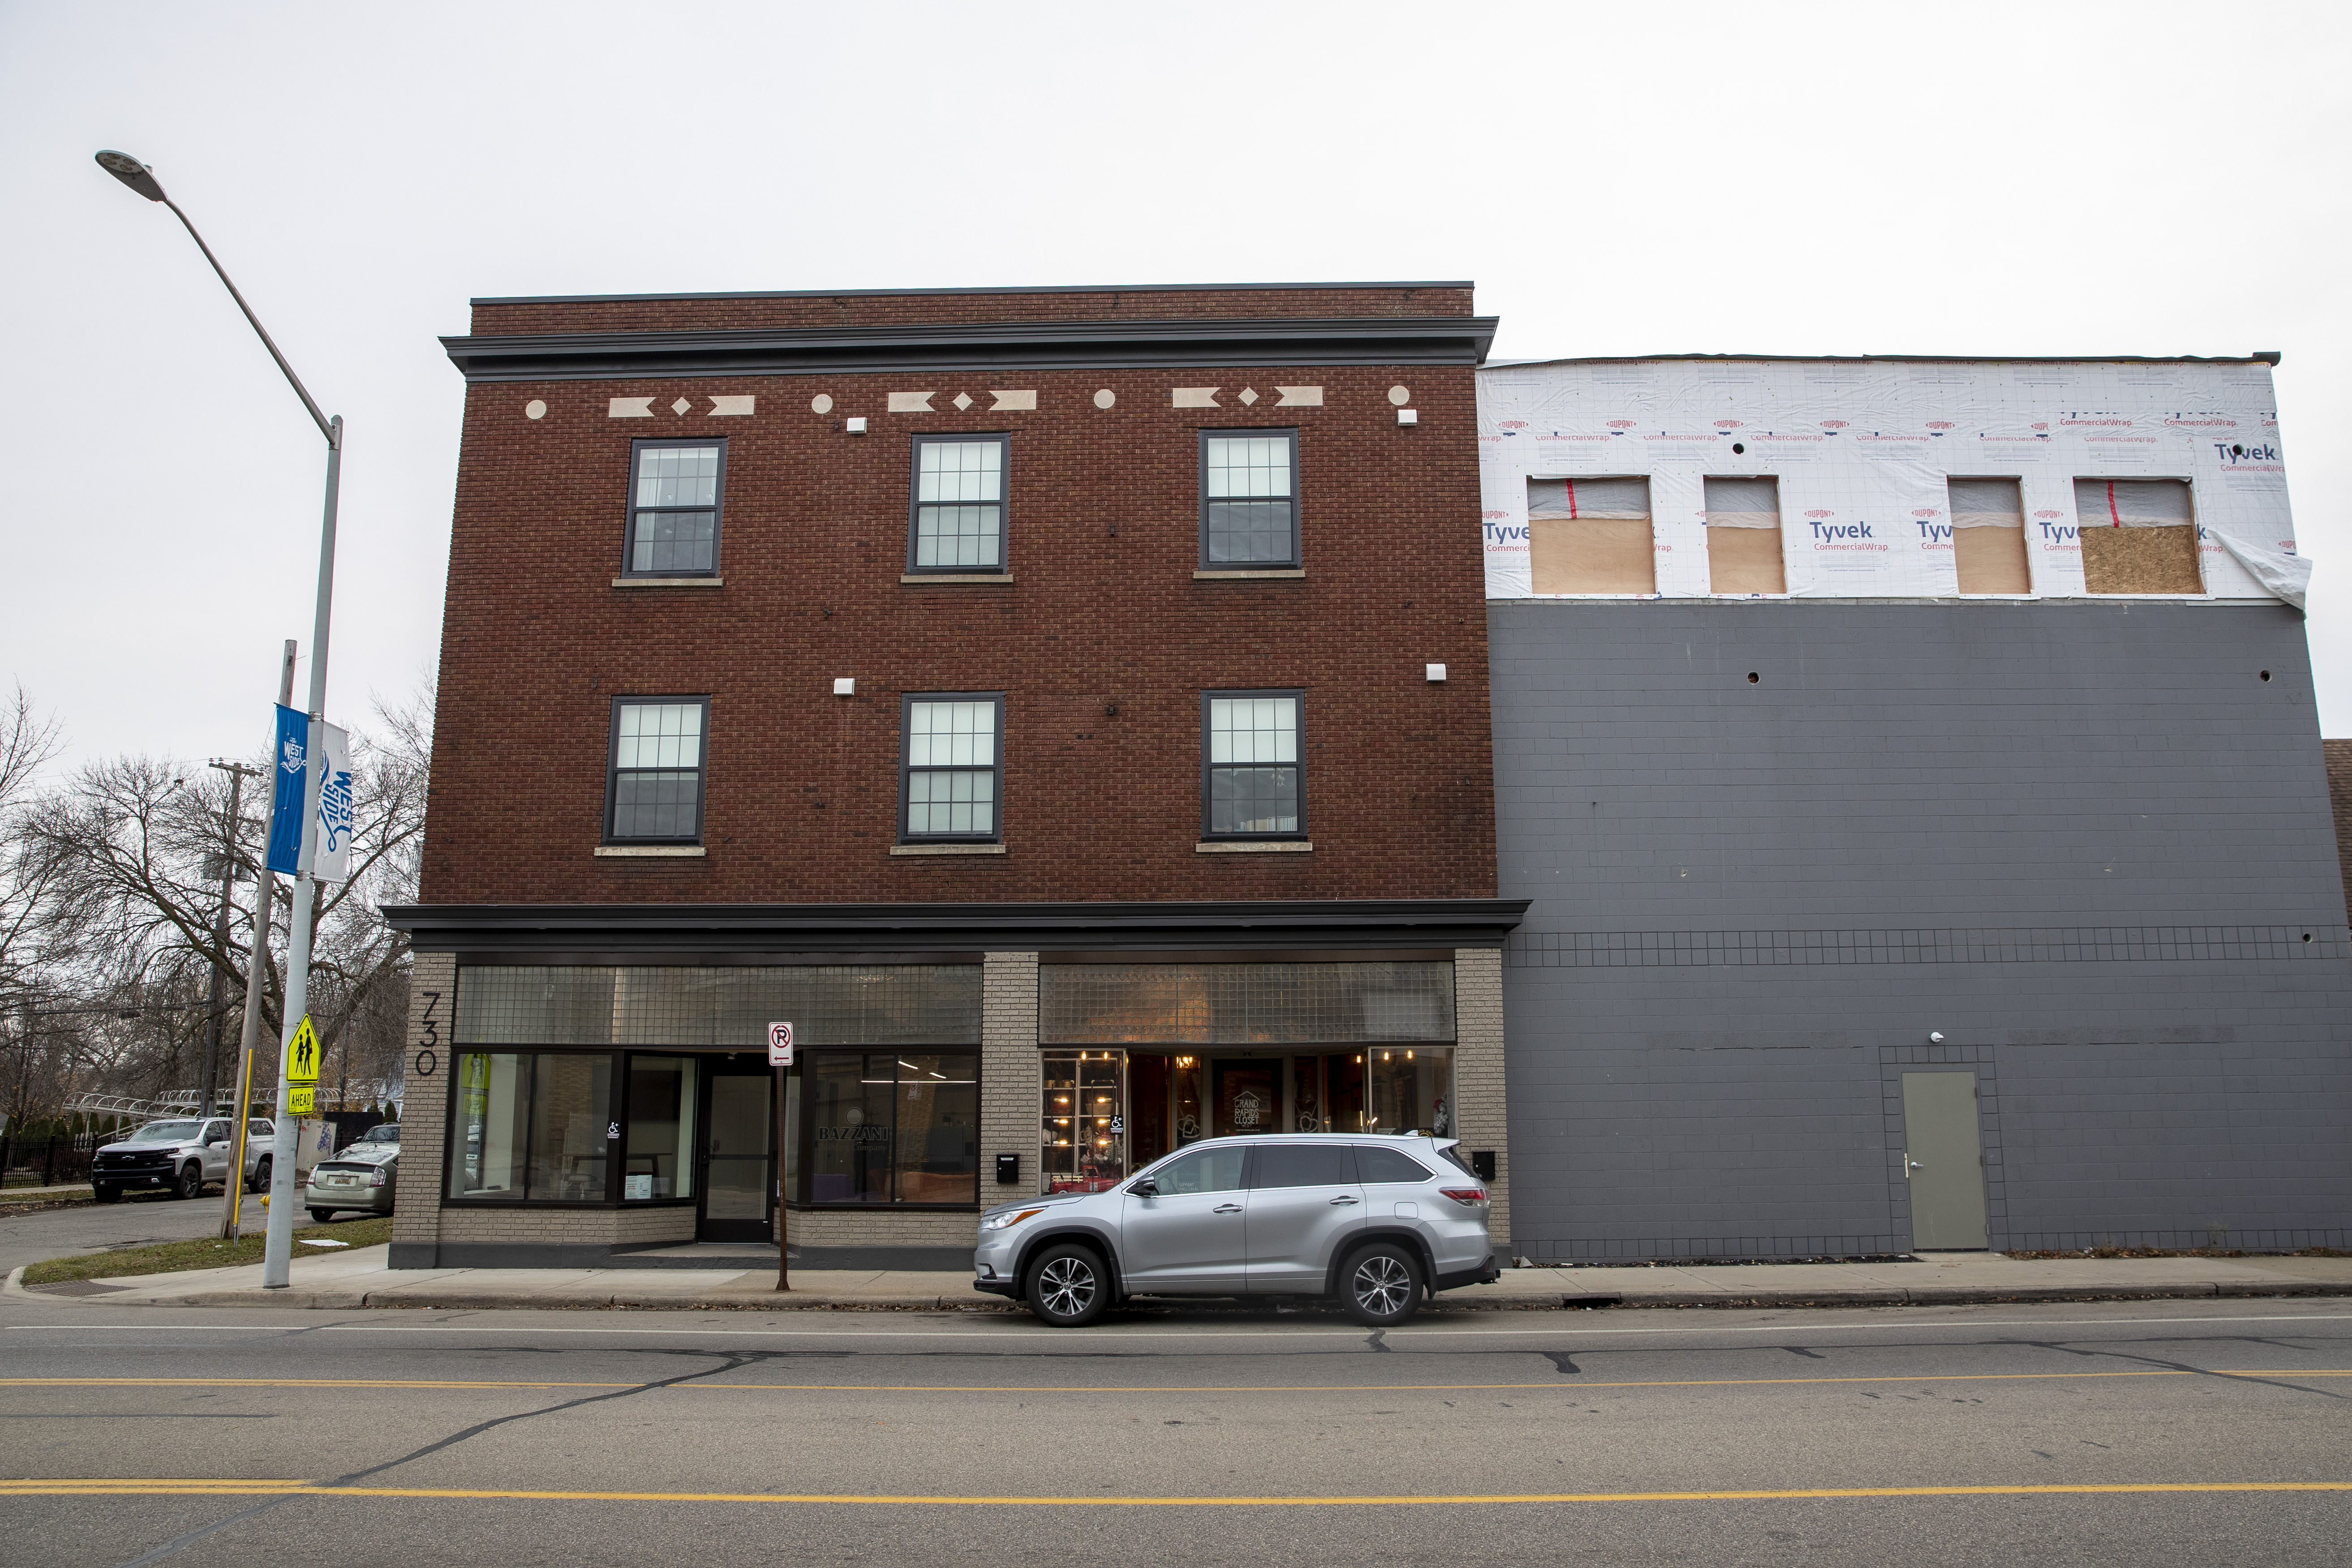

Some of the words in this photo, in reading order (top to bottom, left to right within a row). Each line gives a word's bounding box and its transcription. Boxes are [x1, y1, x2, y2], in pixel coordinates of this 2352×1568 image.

[1502, 421, 1526, 429] DUPONT
[1610, 420, 1633, 429] DUPONT
[1717, 420, 1741, 428] DUPONT
[1823, 420, 1847, 429] DUPONT
[1929, 421, 1952, 430] DUPONT
[2060, 419, 2132, 427] CommercialWrap
[2164, 419, 2236, 427] CommercialWrap
[2214, 443, 2276, 464] Tyvek
[1482, 511, 1505, 519] DUPONT
[1808, 509, 1832, 518] DUPONT
[1915, 509, 1938, 517] DUPONT
[2037, 510, 2060, 518] DUPONT
[1809, 521, 1873, 543] Tyvek
[2039, 522, 2080, 543] Tyv
[1655, 544, 1672, 552] rap
[1814, 543, 1888, 551] CommercialWrap
[284, 741, 304, 761] WEST
[288, 756, 301, 768] SIDE
[322, 783, 339, 825] SIDE
[333, 771, 353, 841] WEST
[416, 992, 441, 1076] 730
[291, 1093, 311, 1107] AHEAD
[1234, 1099, 1259, 1108] GRAND
[1234, 1108, 1259, 1117] RAPIDS
[818, 1127, 888, 1141] BAZZANI
[852, 1144, 887, 1153] Company
